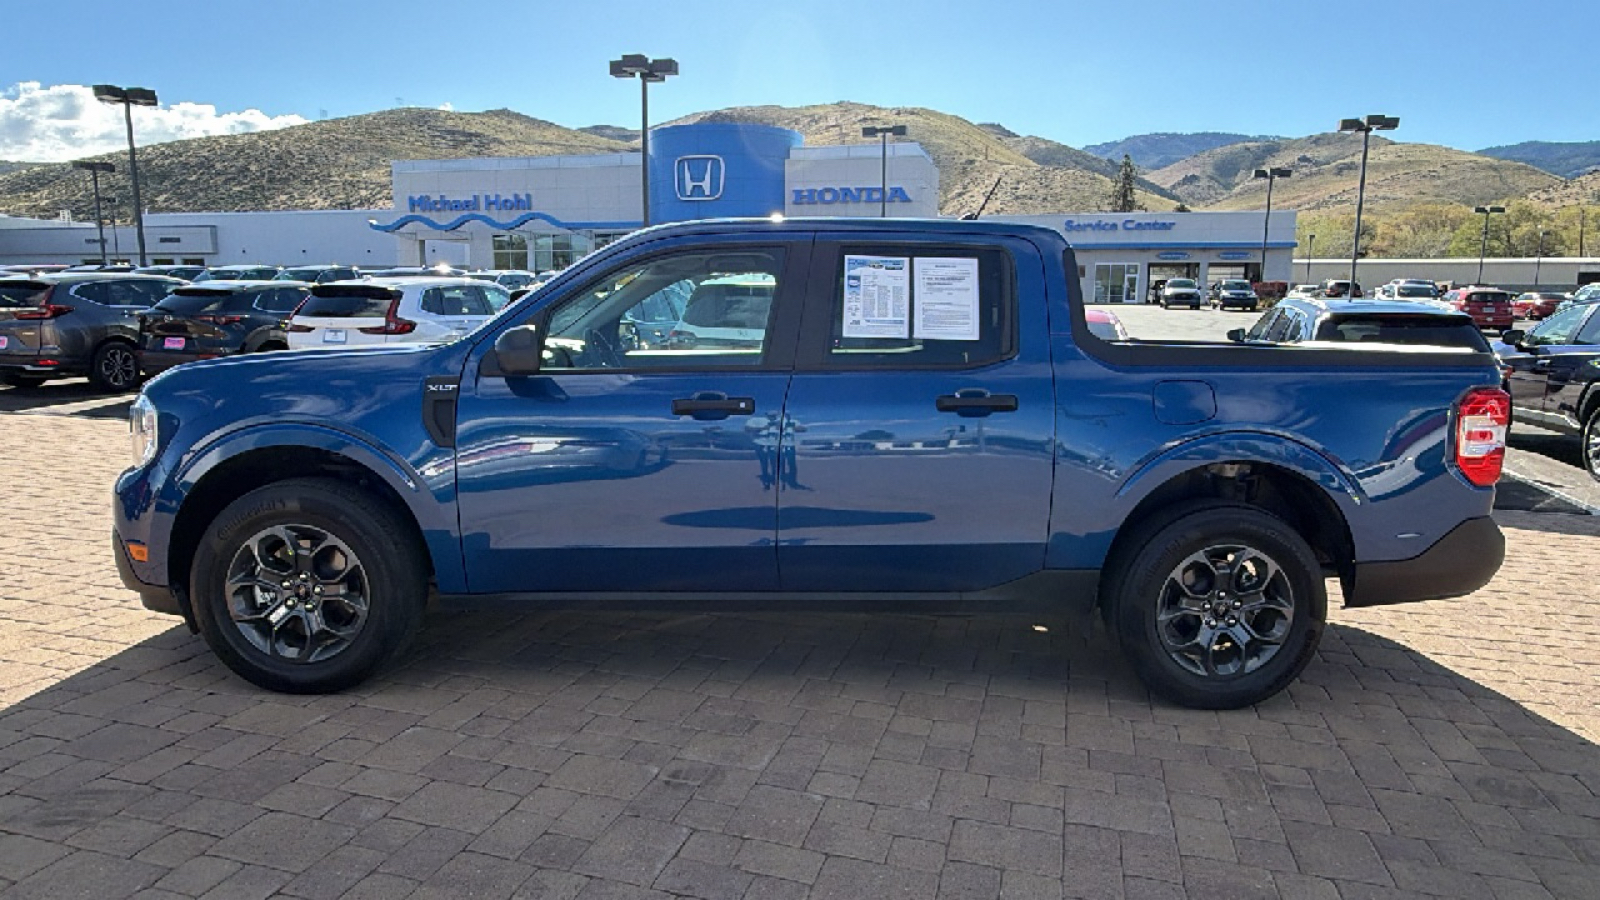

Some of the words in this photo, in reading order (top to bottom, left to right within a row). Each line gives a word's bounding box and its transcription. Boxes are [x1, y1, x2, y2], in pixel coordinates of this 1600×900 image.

[408, 194, 481, 213] Michael
[484, 193, 532, 211] Hohl
[792, 187, 913, 206] HONDA
[1064, 219, 1118, 231] Service
[1121, 219, 1176, 231] Center
